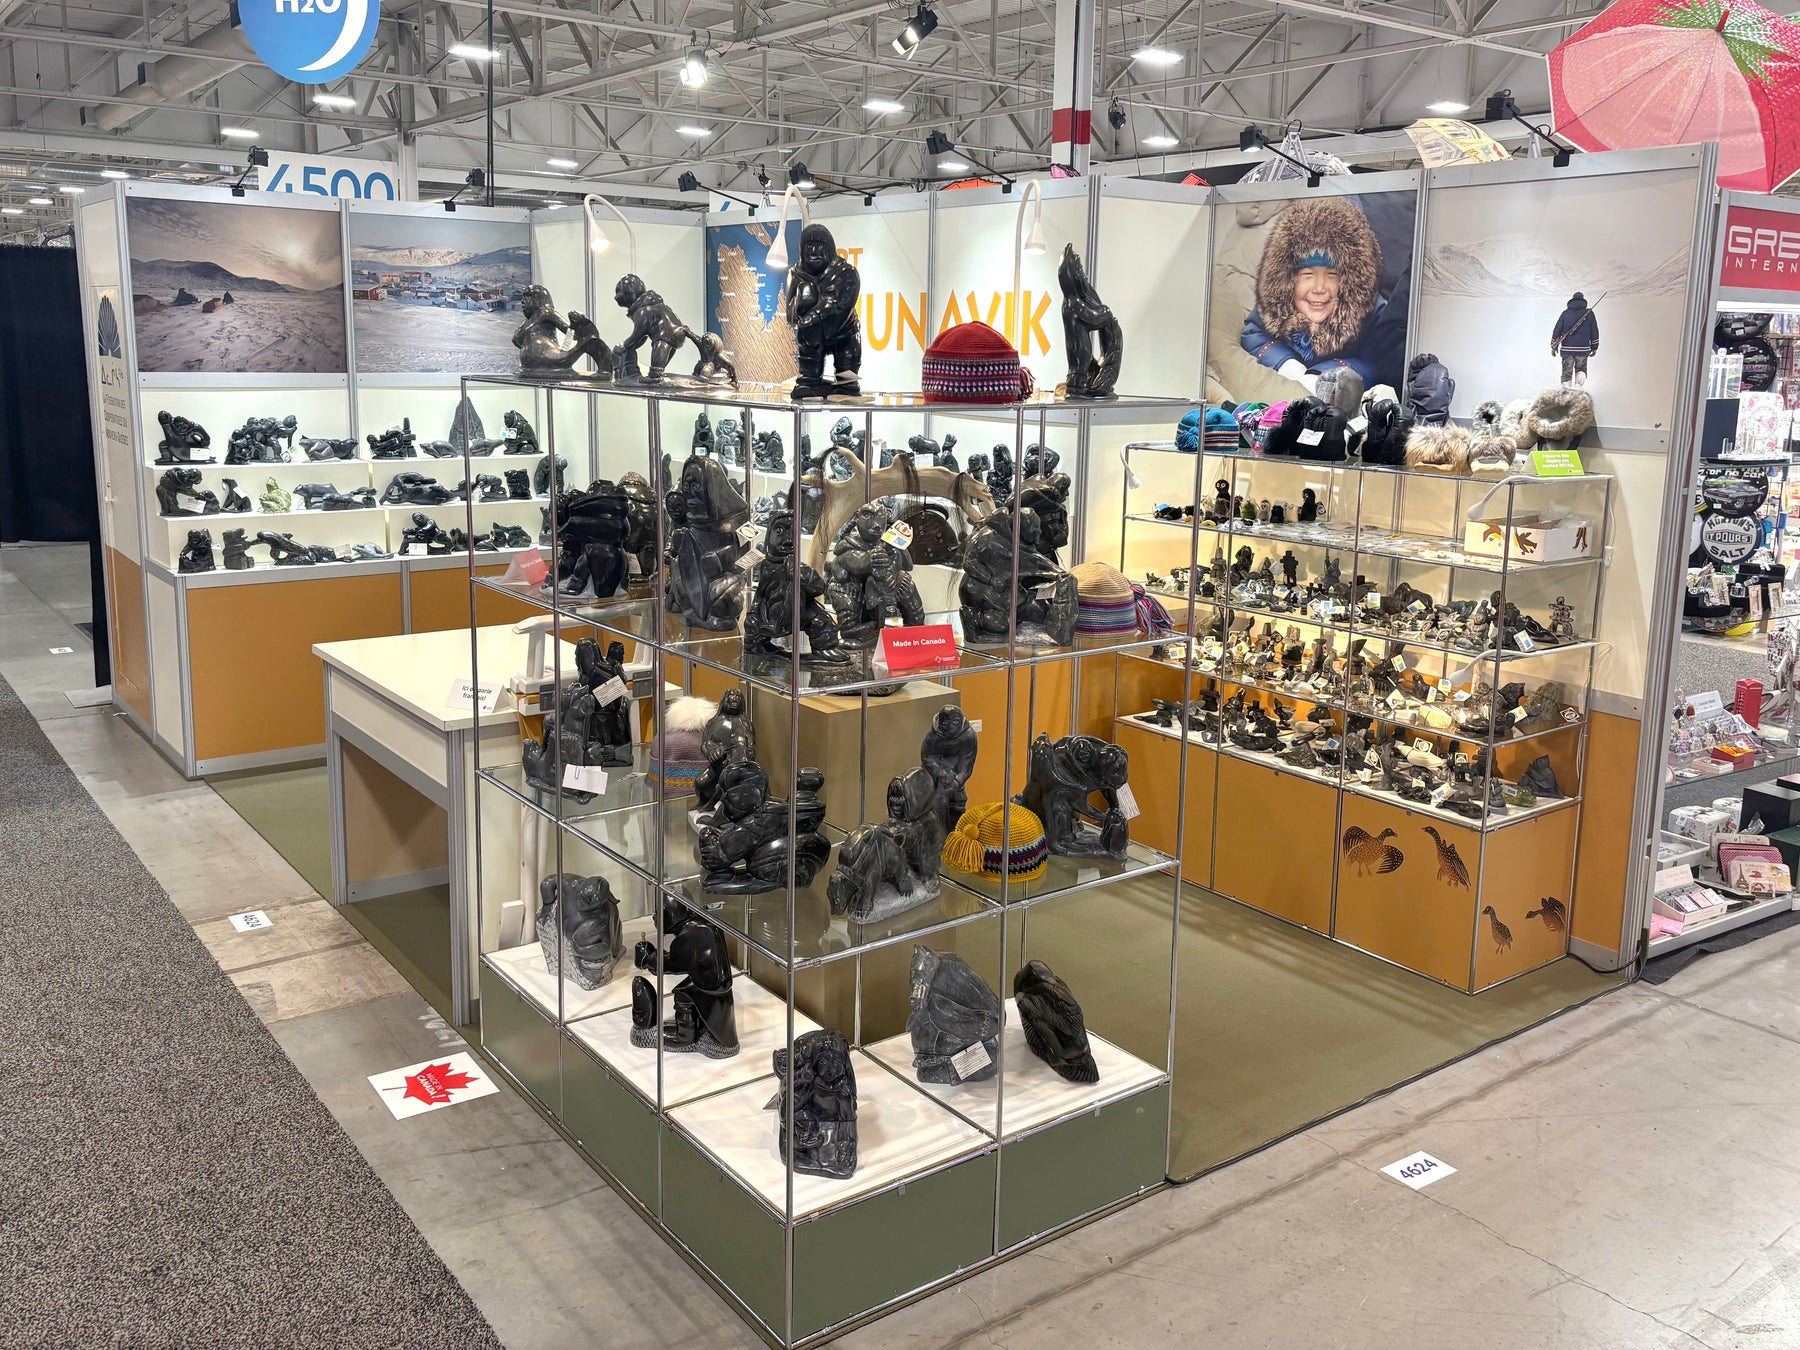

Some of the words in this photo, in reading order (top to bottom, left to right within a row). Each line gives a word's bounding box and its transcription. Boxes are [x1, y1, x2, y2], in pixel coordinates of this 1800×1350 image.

[266, 164, 394, 201] 4500
[1725, 256, 1798, 273] INTERN
[857, 288, 1052, 357] UNAVIK
[1706, 533, 1715, 542] IT
[1716, 532, 1748, 544] POURS
[1710, 545, 1746, 558] SALT
[1400, 1158, 1438, 1178] 4624
